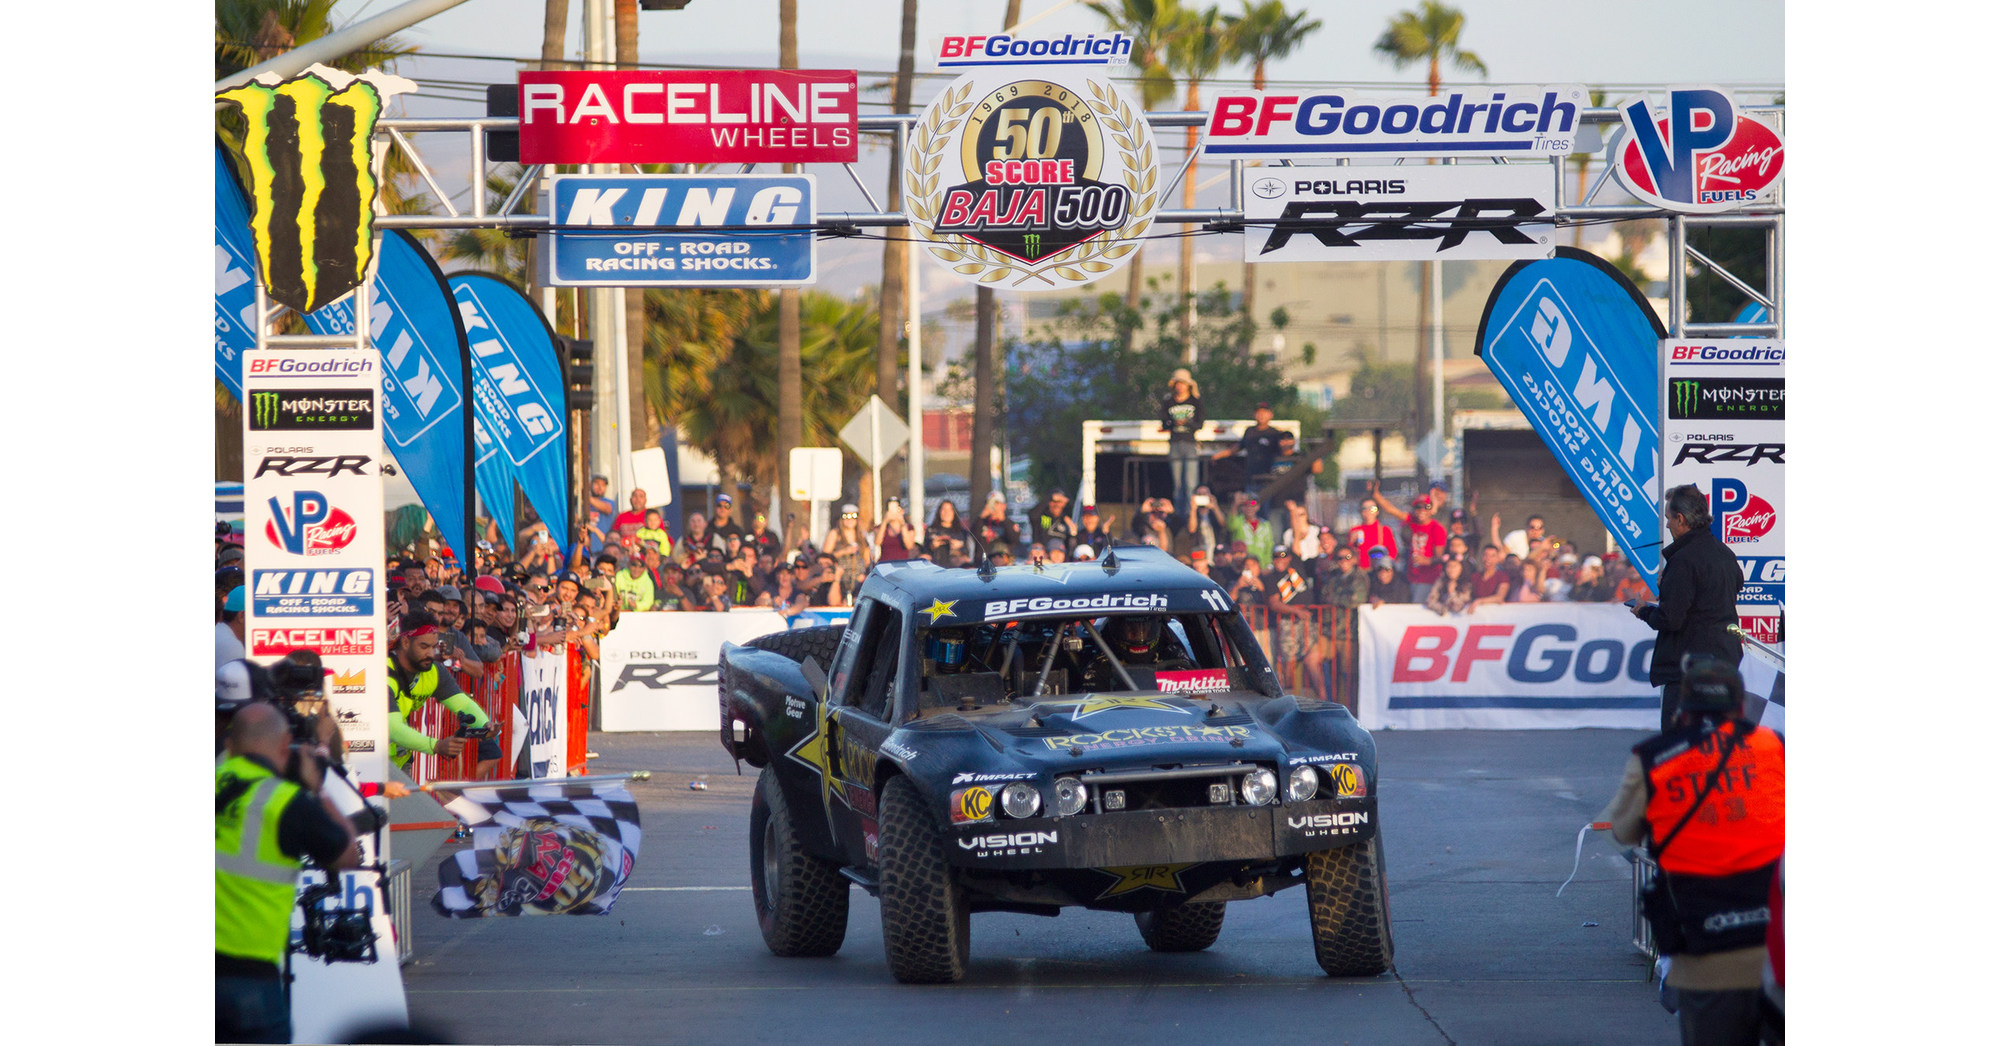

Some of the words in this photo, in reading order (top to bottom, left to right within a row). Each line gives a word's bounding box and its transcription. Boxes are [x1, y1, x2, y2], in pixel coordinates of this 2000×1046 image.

[940, 33, 1131, 58] BFGoodrich
[1108, 56, 1127, 65] Tires
[523, 83, 850, 124] RACELINE
[1208, 91, 1576, 137] BFGoodrich
[710, 127, 850, 147] WHEELS
[1534, 136, 1569, 151] Tires
[1626, 89, 1734, 204] VP
[986, 159, 1075, 185] SCORE
[1699, 145, 1784, 190] Racing
[1294, 179, 1406, 196] POLARIS
[1701, 190, 1757, 202] FUELS
[565, 186, 802, 226] KING
[940, 188, 1046, 226] BAJA
[1054, 185, 1128, 227] 500
[1259, 198, 1547, 254] RZR
[613, 241, 660, 255] OFF
[680, 241, 751, 255] ROAD
[586, 257, 675, 270] RACING
[250, 359, 373, 373] BFGoodrich
[457, 299, 554, 437] KING
[281, 397, 372, 414] MONSTER
[1716, 404, 1780, 412] ENERGY
[1686, 434, 1734, 442] POLARIS
[266, 446, 314, 454] POLARIS
[253, 455, 373, 480] RZR
[267, 490, 328, 556] VP
[1727, 511, 1776, 535] Racing
[307, 523, 356, 547] Racing
[255, 570, 372, 595] KING
[279, 598, 303, 606] OFF
[310, 598, 347, 606] ROAD
[985, 593, 1168, 616] BFGoodrich
[1201, 589, 1230, 611] 11
[265, 606, 311, 614] RACING
[253, 629, 373, 646] RACELINE
[321, 645, 373, 654] WHEELS
[629, 651, 698, 659] POLARIS
[1392, 623, 1656, 684] BFGoo
[610, 663, 719, 693] RZ
[1084, 737, 1158, 750] NERGY
[1308, 753, 1359, 762] IMPACT
[974, 772, 1038, 781] IMPACT
[1333, 765, 1355, 794] KC
[963, 788, 990, 818] KC
[1288, 811, 1369, 829] VISION
[958, 831, 1058, 850] VISION
[1305, 827, 1359, 837] WHEEL
[976, 847, 1043, 858] WHEEL
